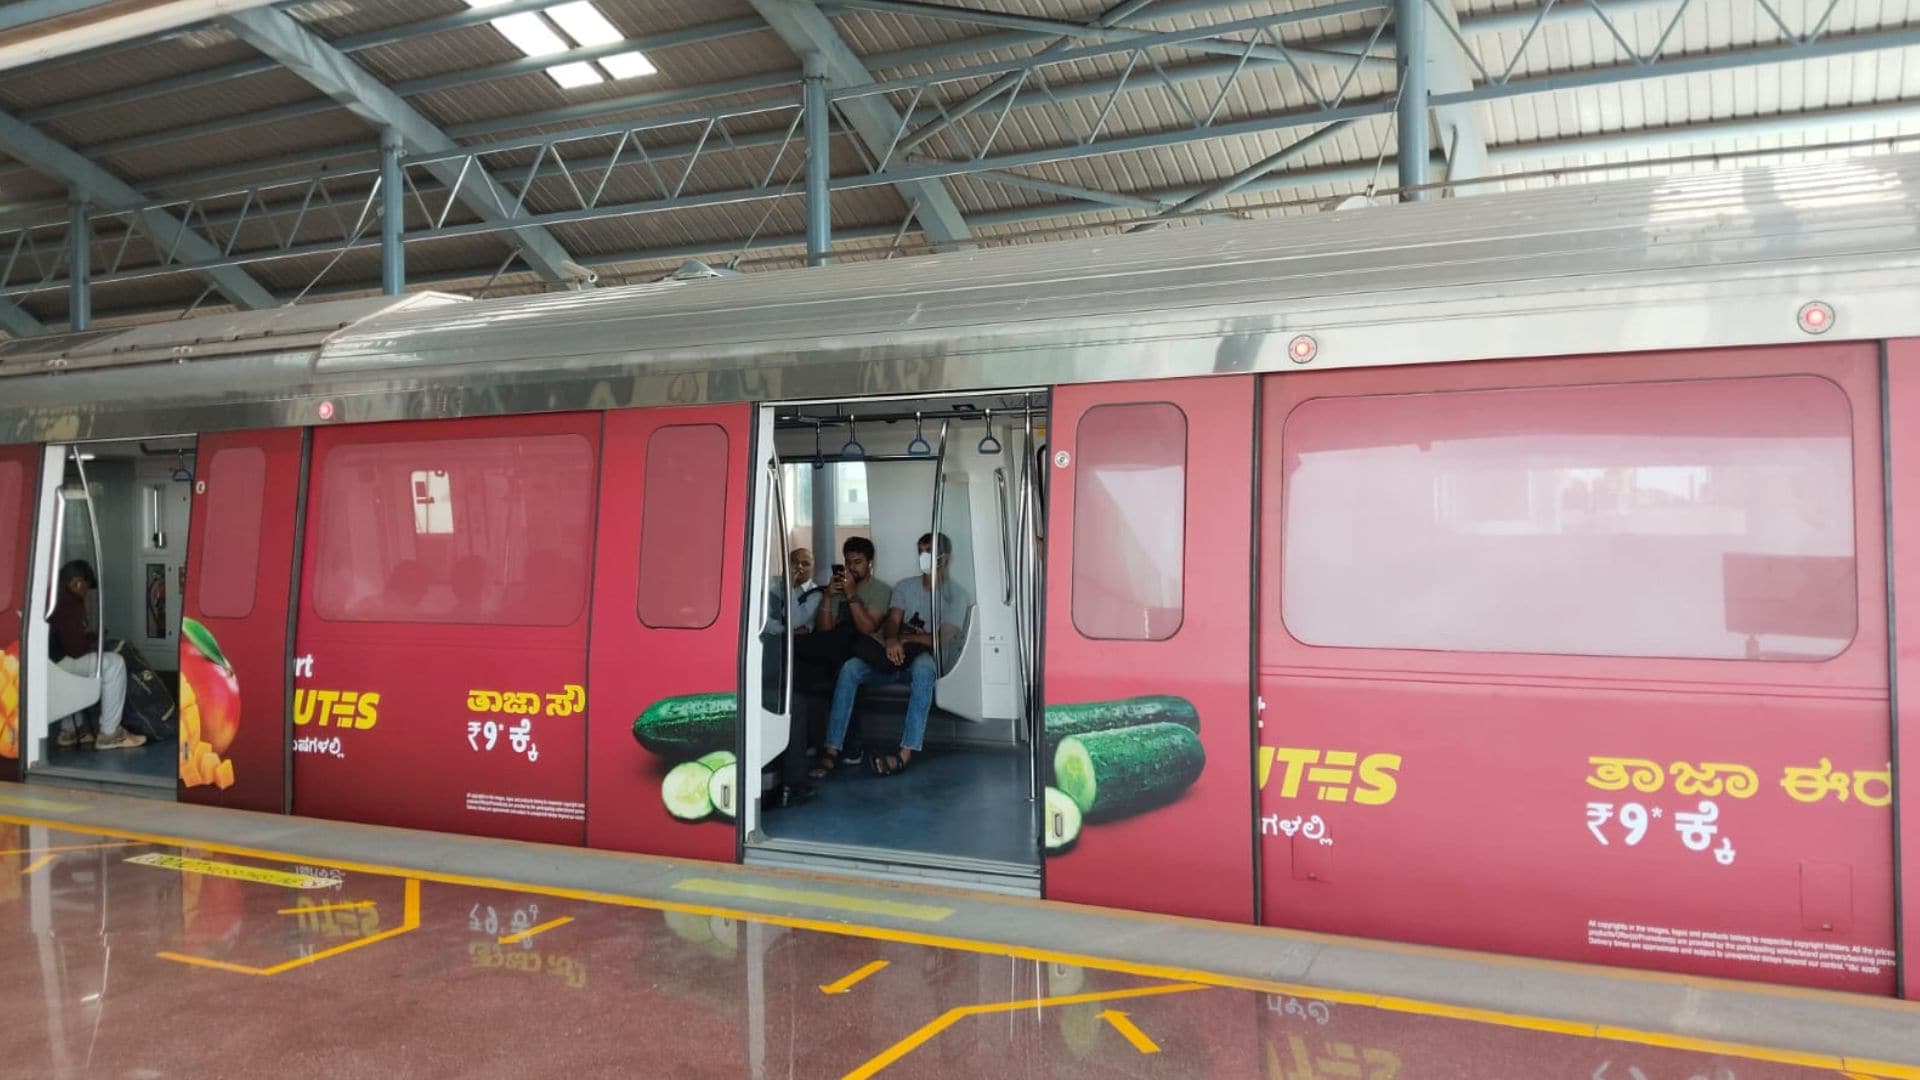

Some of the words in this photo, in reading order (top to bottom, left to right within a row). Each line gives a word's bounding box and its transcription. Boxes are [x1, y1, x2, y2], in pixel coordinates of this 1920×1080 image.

[466, 688, 541, 716] ತಾಜಾ
[508, 717, 540, 763] ಕ್ಕೆ
[1585, 756, 1760, 799] ತಾಜಾ
[1674, 800, 1737, 866] ಕ್ಕೆ
